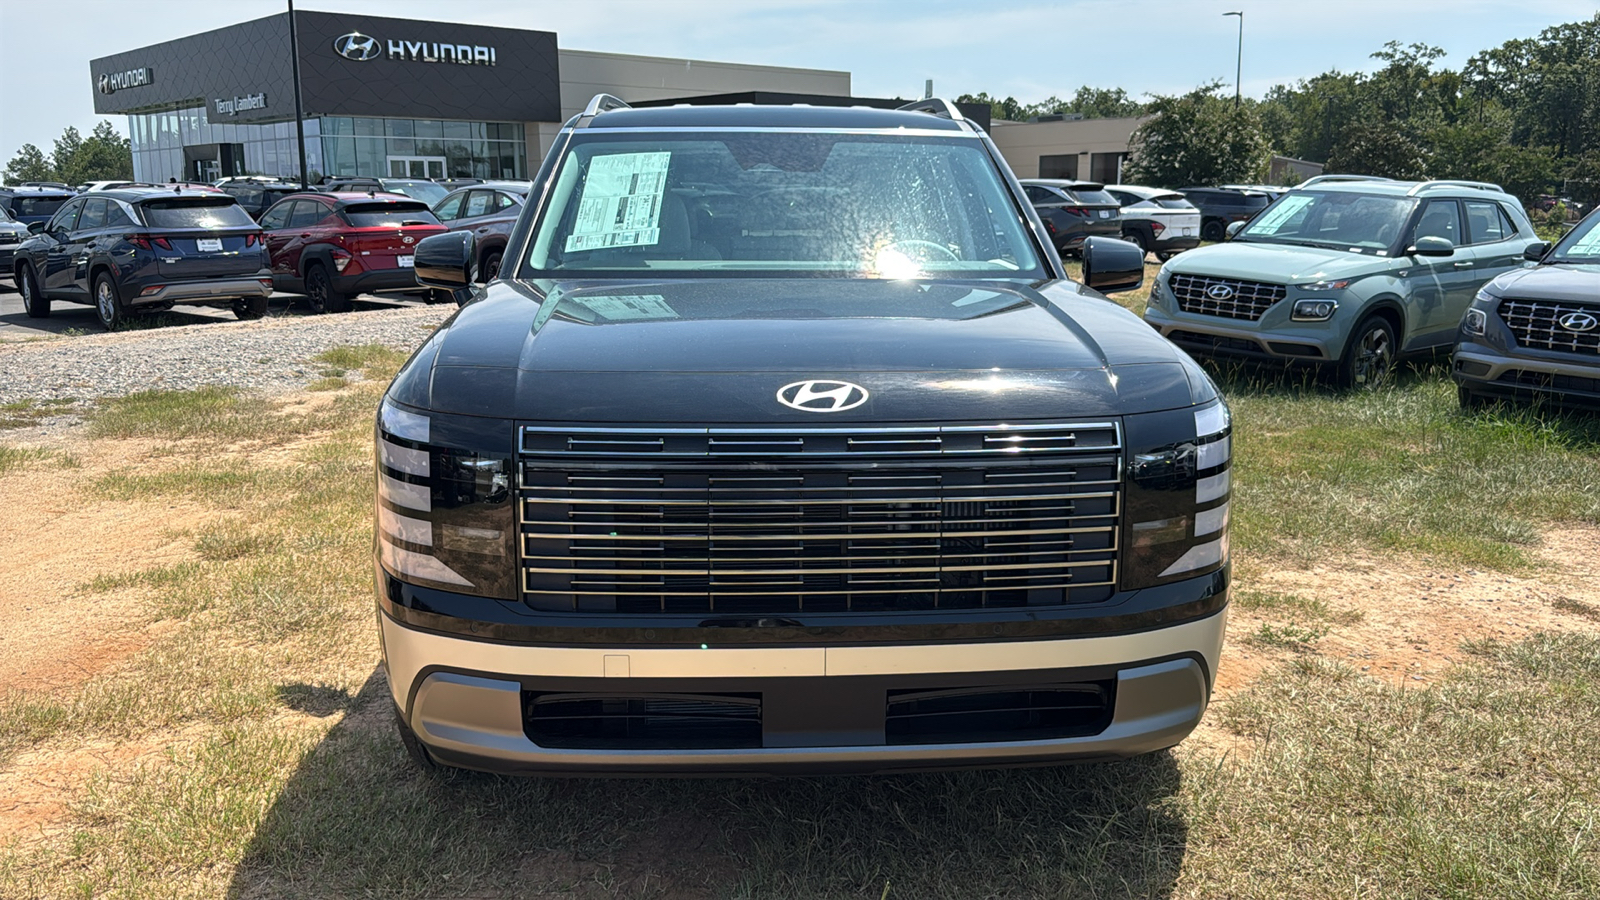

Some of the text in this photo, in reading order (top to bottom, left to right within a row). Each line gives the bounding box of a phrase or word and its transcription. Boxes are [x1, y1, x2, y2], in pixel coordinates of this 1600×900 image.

[387, 39, 496, 66] HYUNDAI
[110, 68, 148, 90] HYUNDAI
[214, 93, 266, 116] Terry Lambert
